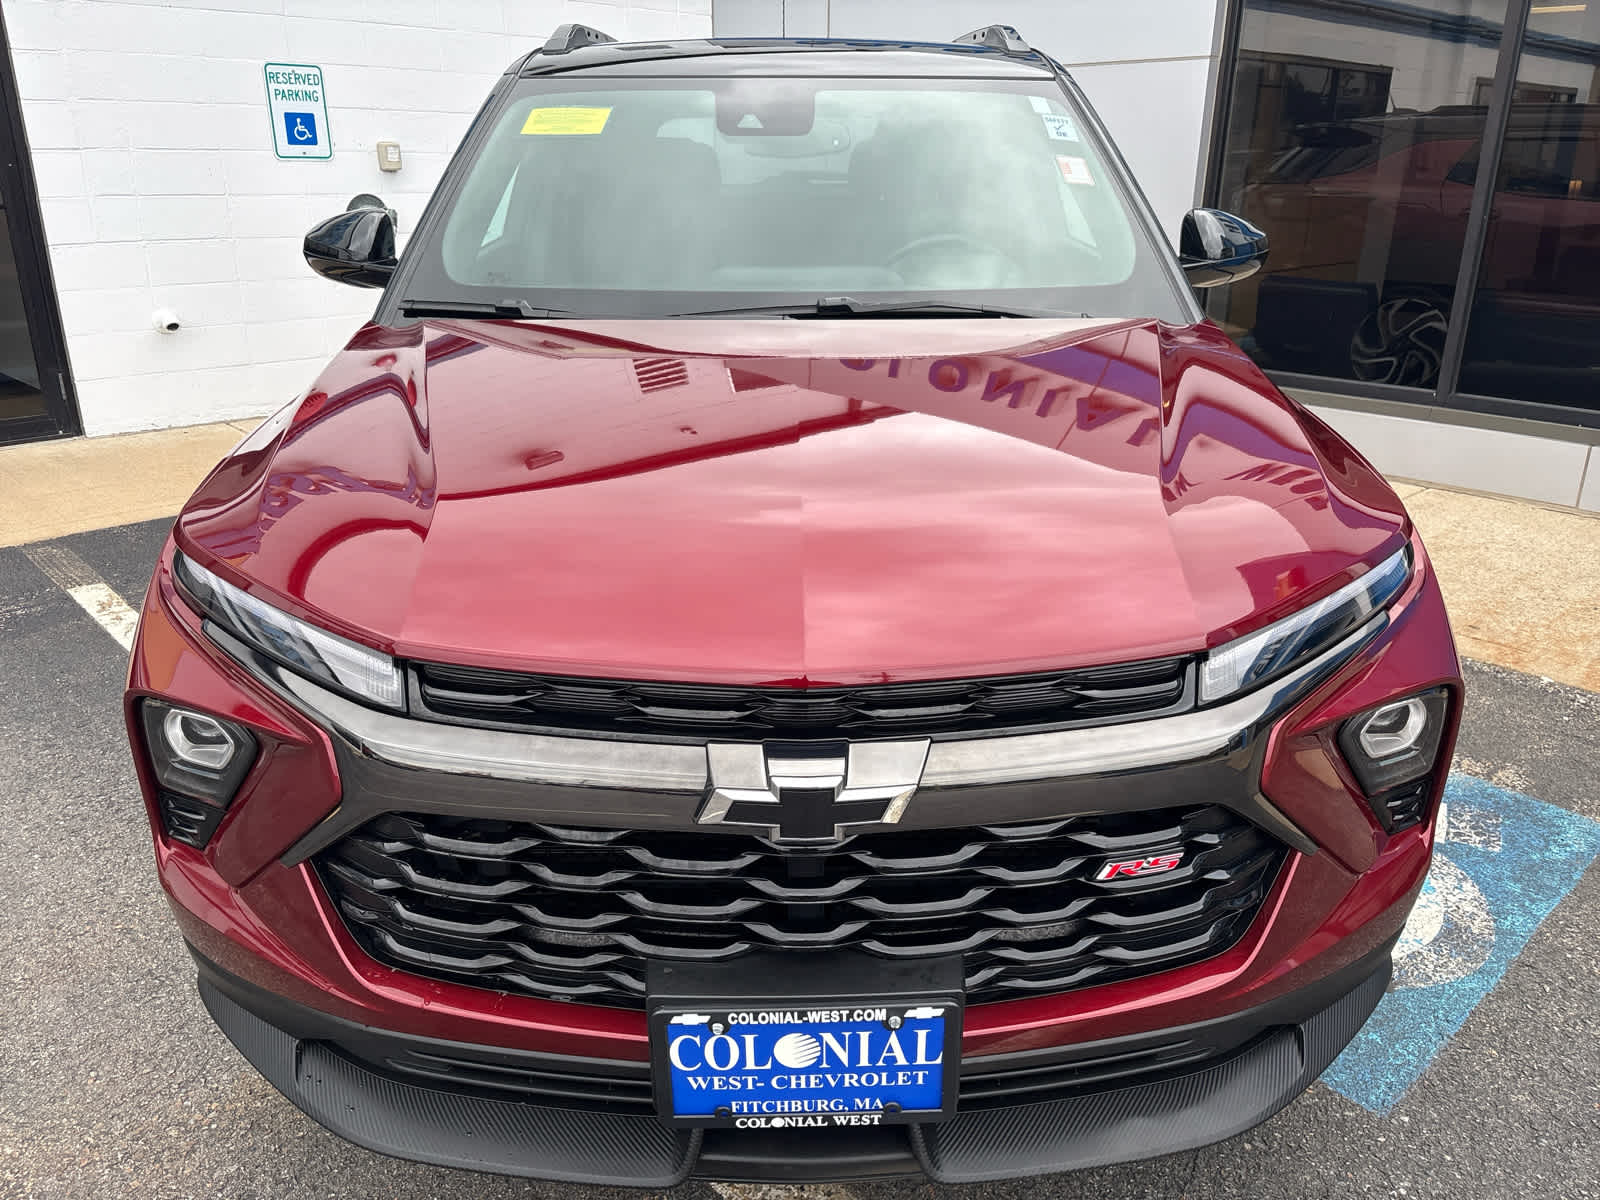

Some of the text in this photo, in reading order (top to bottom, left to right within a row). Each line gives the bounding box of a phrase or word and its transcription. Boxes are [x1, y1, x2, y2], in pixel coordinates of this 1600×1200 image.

[268, 71, 320, 85] RESERVED
[274, 88, 319, 102] PARKING
[1096, 852, 1184, 880] RS
[727, 1008, 887, 1025] COLONIAL-WEST.COM
[669, 1029, 943, 1071] COLONIAL
[770, 1071, 929, 1090] CHEVROLET
[731, 1097, 884, 1114] FITCHBURG, MA
[735, 1114, 882, 1129] COLONIAL WEST
